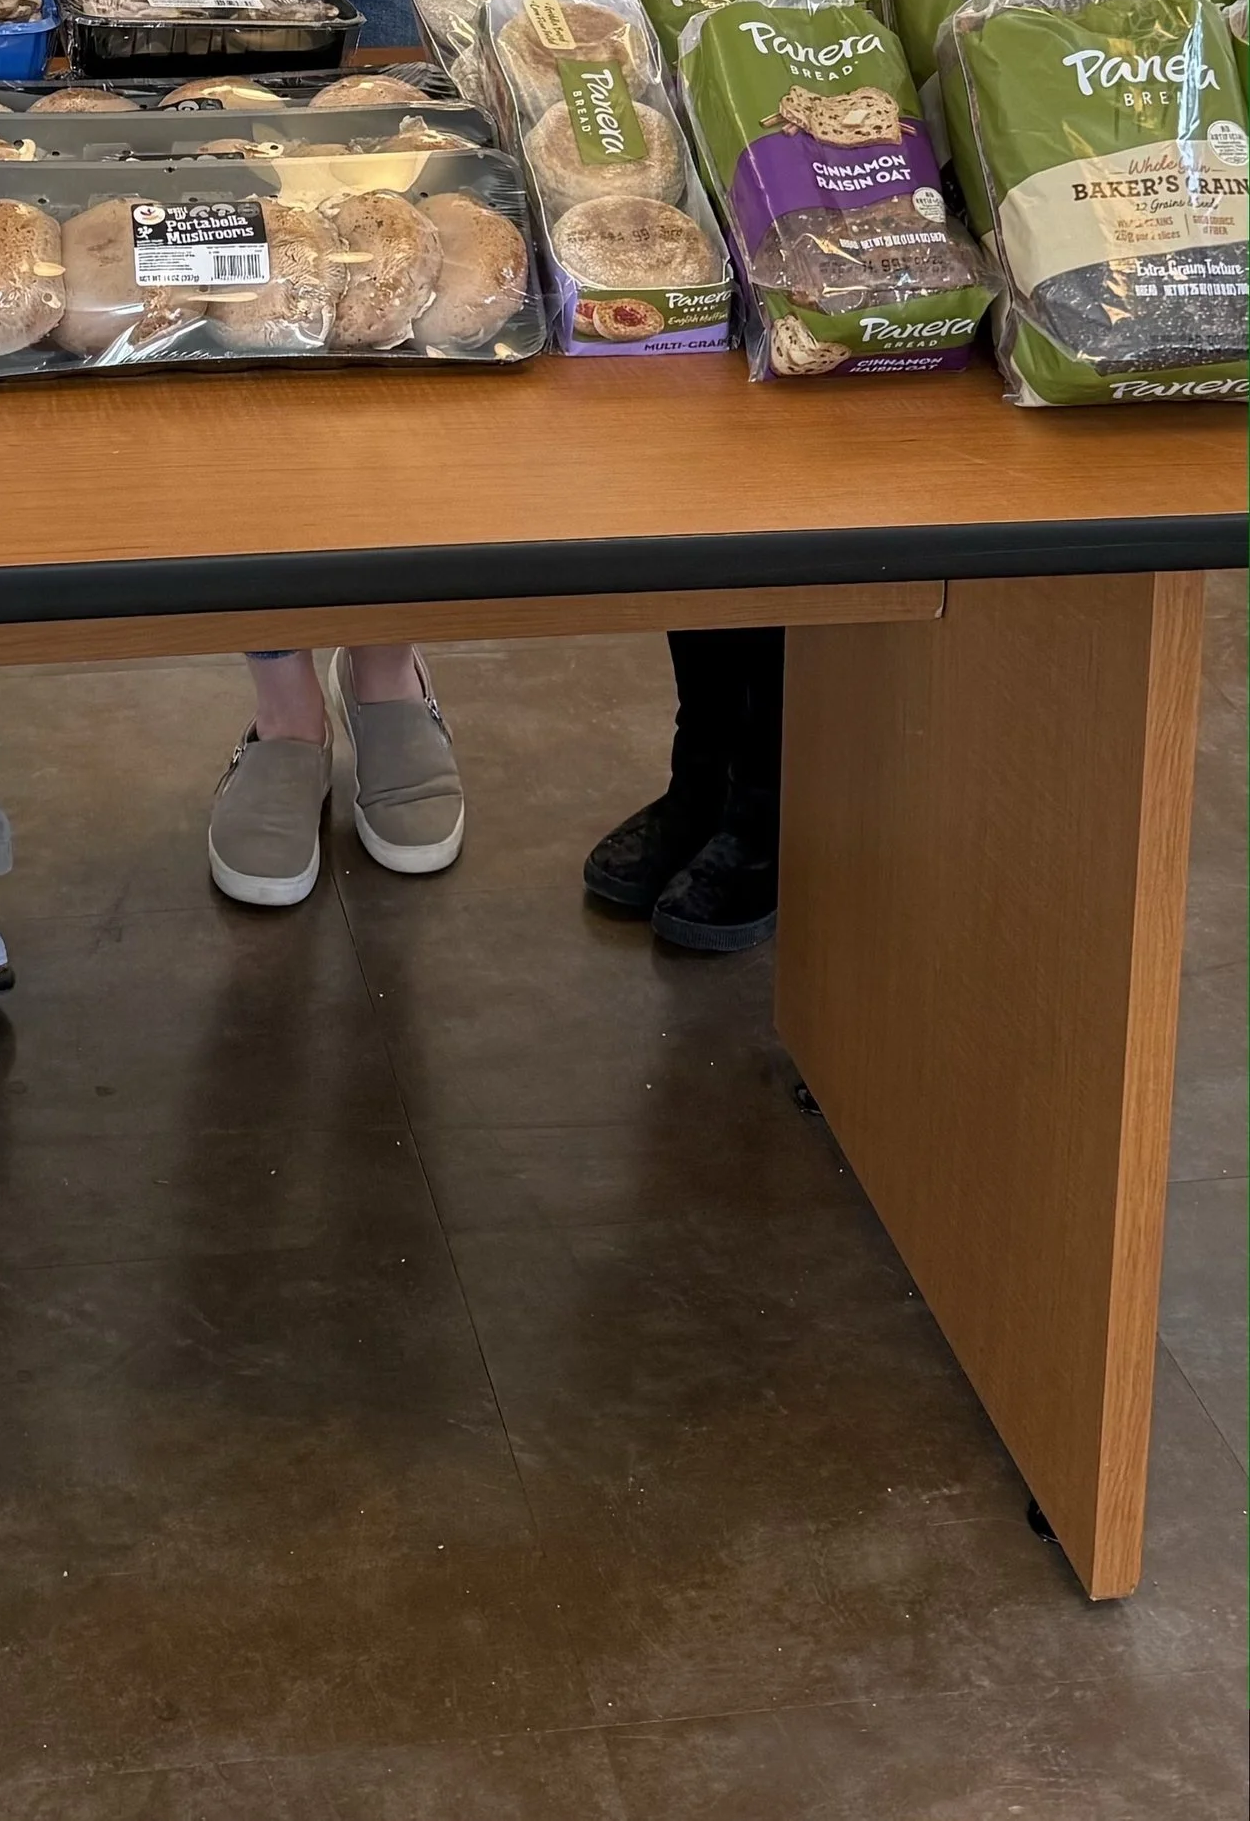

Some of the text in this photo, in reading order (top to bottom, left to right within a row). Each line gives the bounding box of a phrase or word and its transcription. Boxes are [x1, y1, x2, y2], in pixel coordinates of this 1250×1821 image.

[738, 21, 886, 67] Panera
[790, 64, 853, 81] BREAD
[1062, 49, 1221, 96] Panea
[572, 90, 592, 133] BREAD
[580, 68, 625, 155] Panera
[812, 155, 907, 178] CINNAMON
[1128, 153, 1177, 175] Whole
[815, 169, 911, 192] RAISIN OAT
[1072, 173, 1180, 201] BAKER'S
[1135, 203, 1147, 212] 12
[1149, 199, 1186, 213] Grains
[165, 215, 249, 232] Portabella
[166, 226, 255, 245] Mushrooms
[1135, 258, 1245, 279] Extra Grainy Texture
[859, 317, 977, 342] Panera
[883, 339, 939, 349] BREAD
[856, 357, 943, 368] CINNAMON
